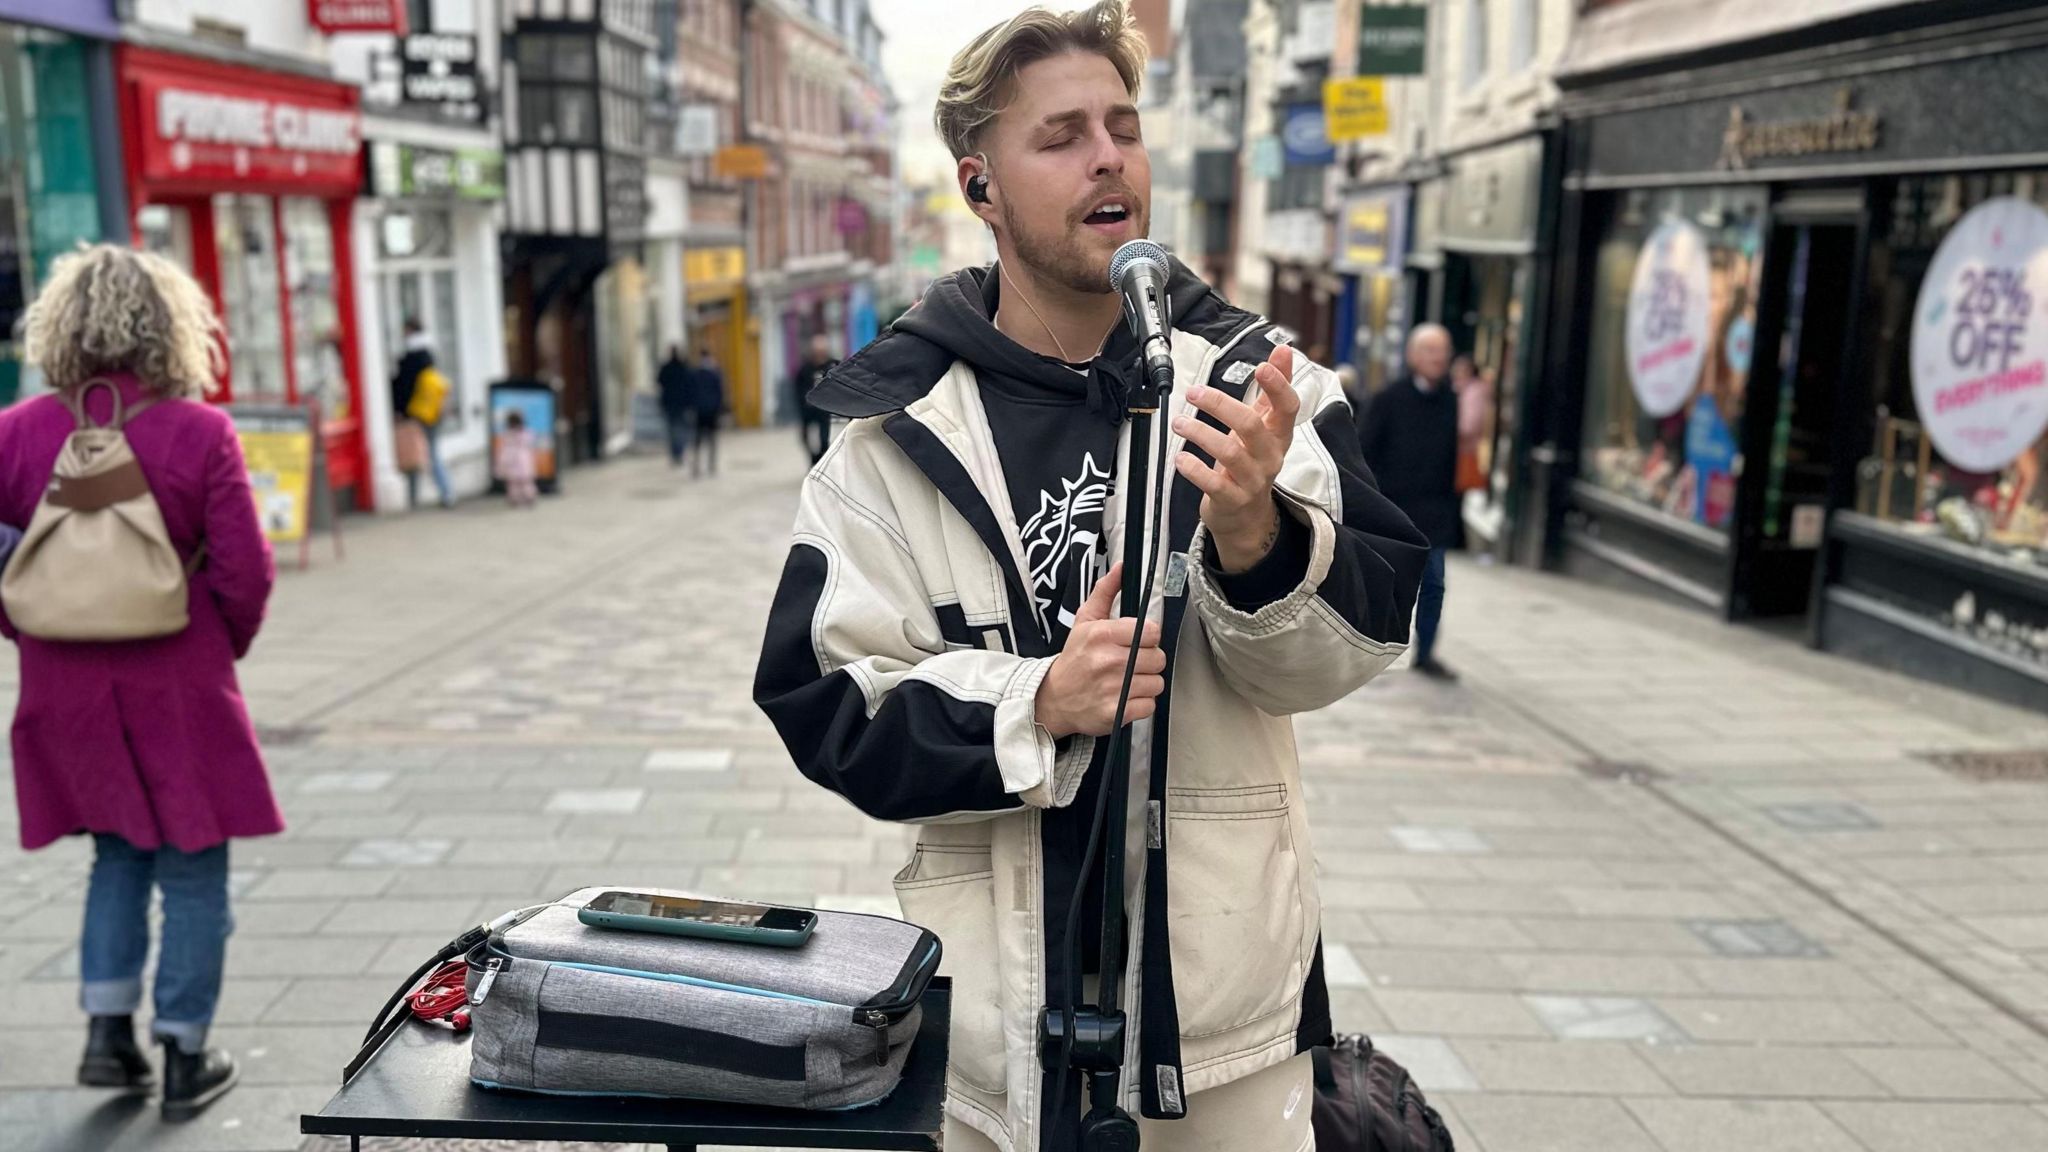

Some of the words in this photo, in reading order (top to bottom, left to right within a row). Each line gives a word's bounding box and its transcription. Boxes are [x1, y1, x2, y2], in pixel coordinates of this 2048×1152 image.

[158, 88, 272, 146] PHONE
[1956, 268, 2032, 320] 25%
[1950, 320, 2025, 371] OFF
